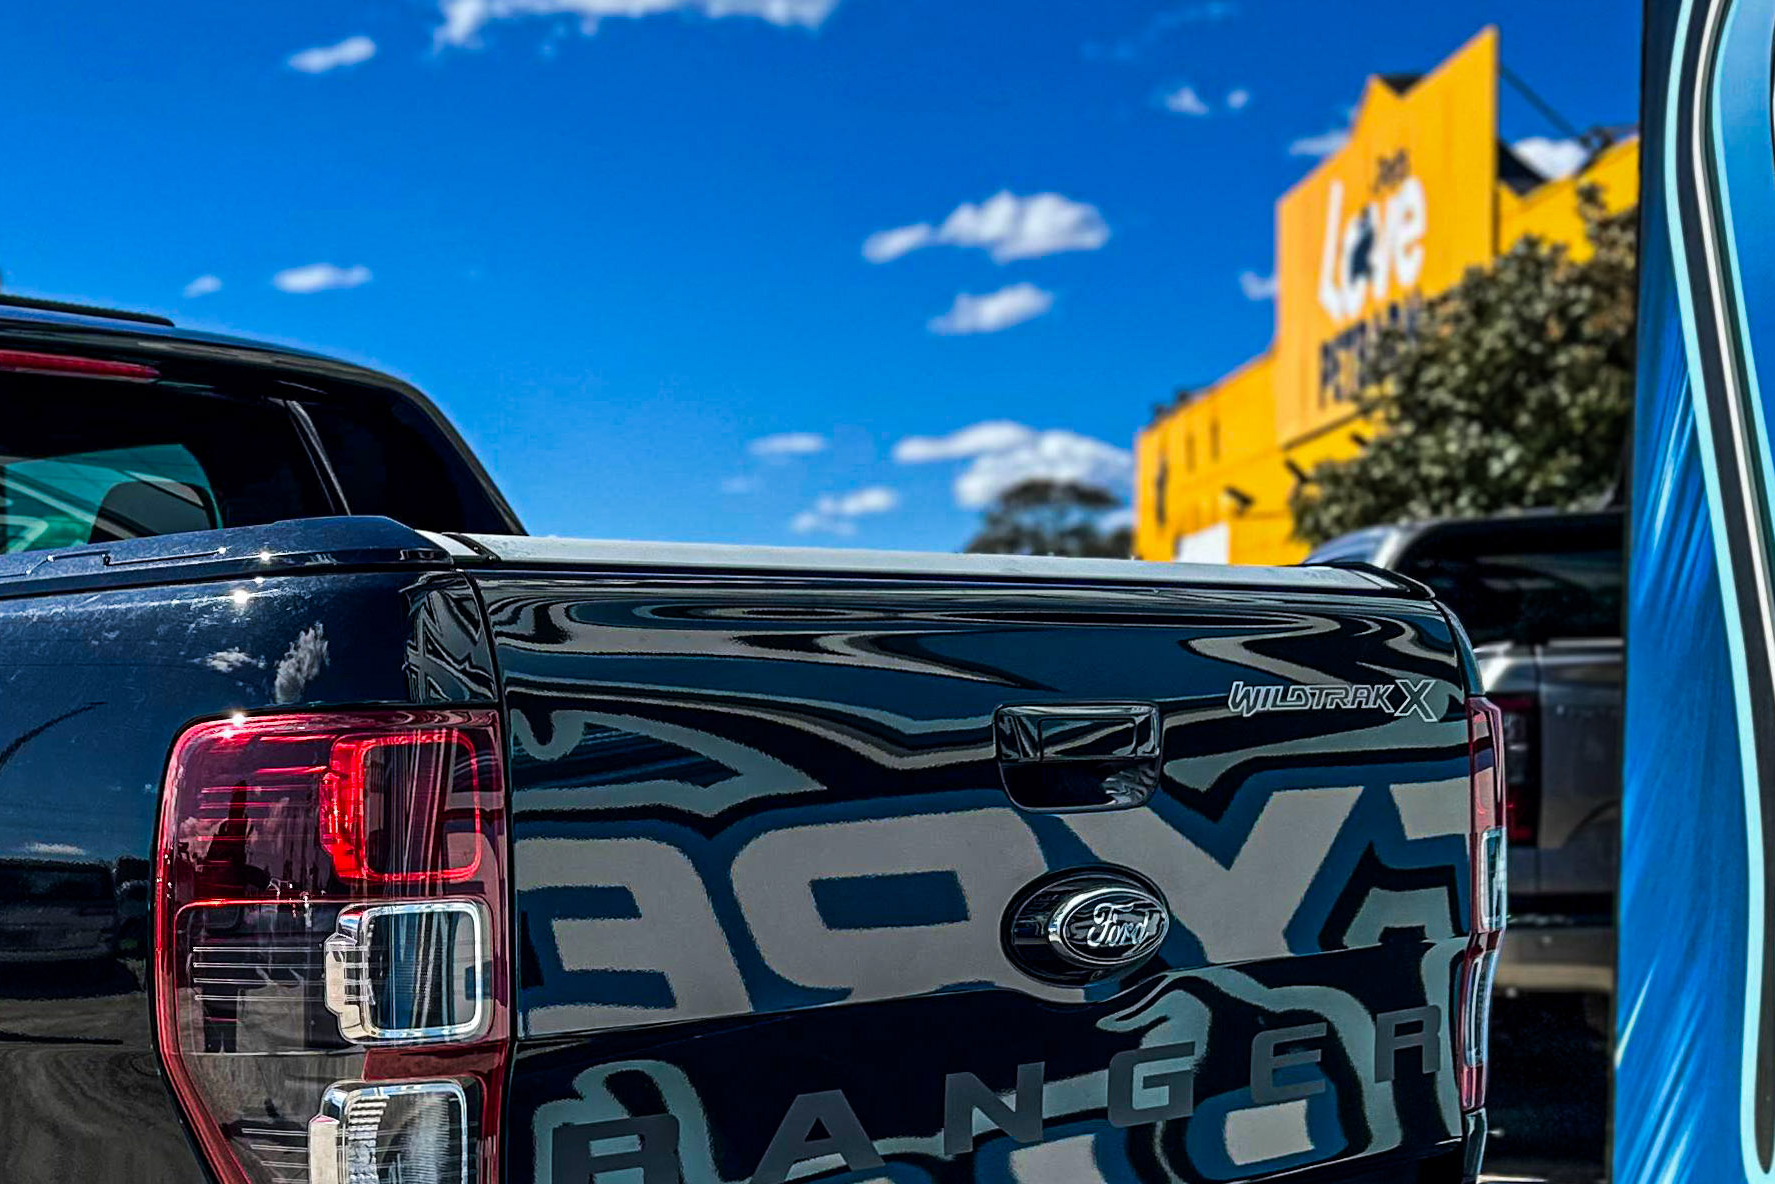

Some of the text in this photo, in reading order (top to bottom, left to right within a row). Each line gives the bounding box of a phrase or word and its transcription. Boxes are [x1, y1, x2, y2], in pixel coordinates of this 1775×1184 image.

[1228, 679, 1438, 722] WILDTRAK X
[1087, 902, 1150, 948] Ford
